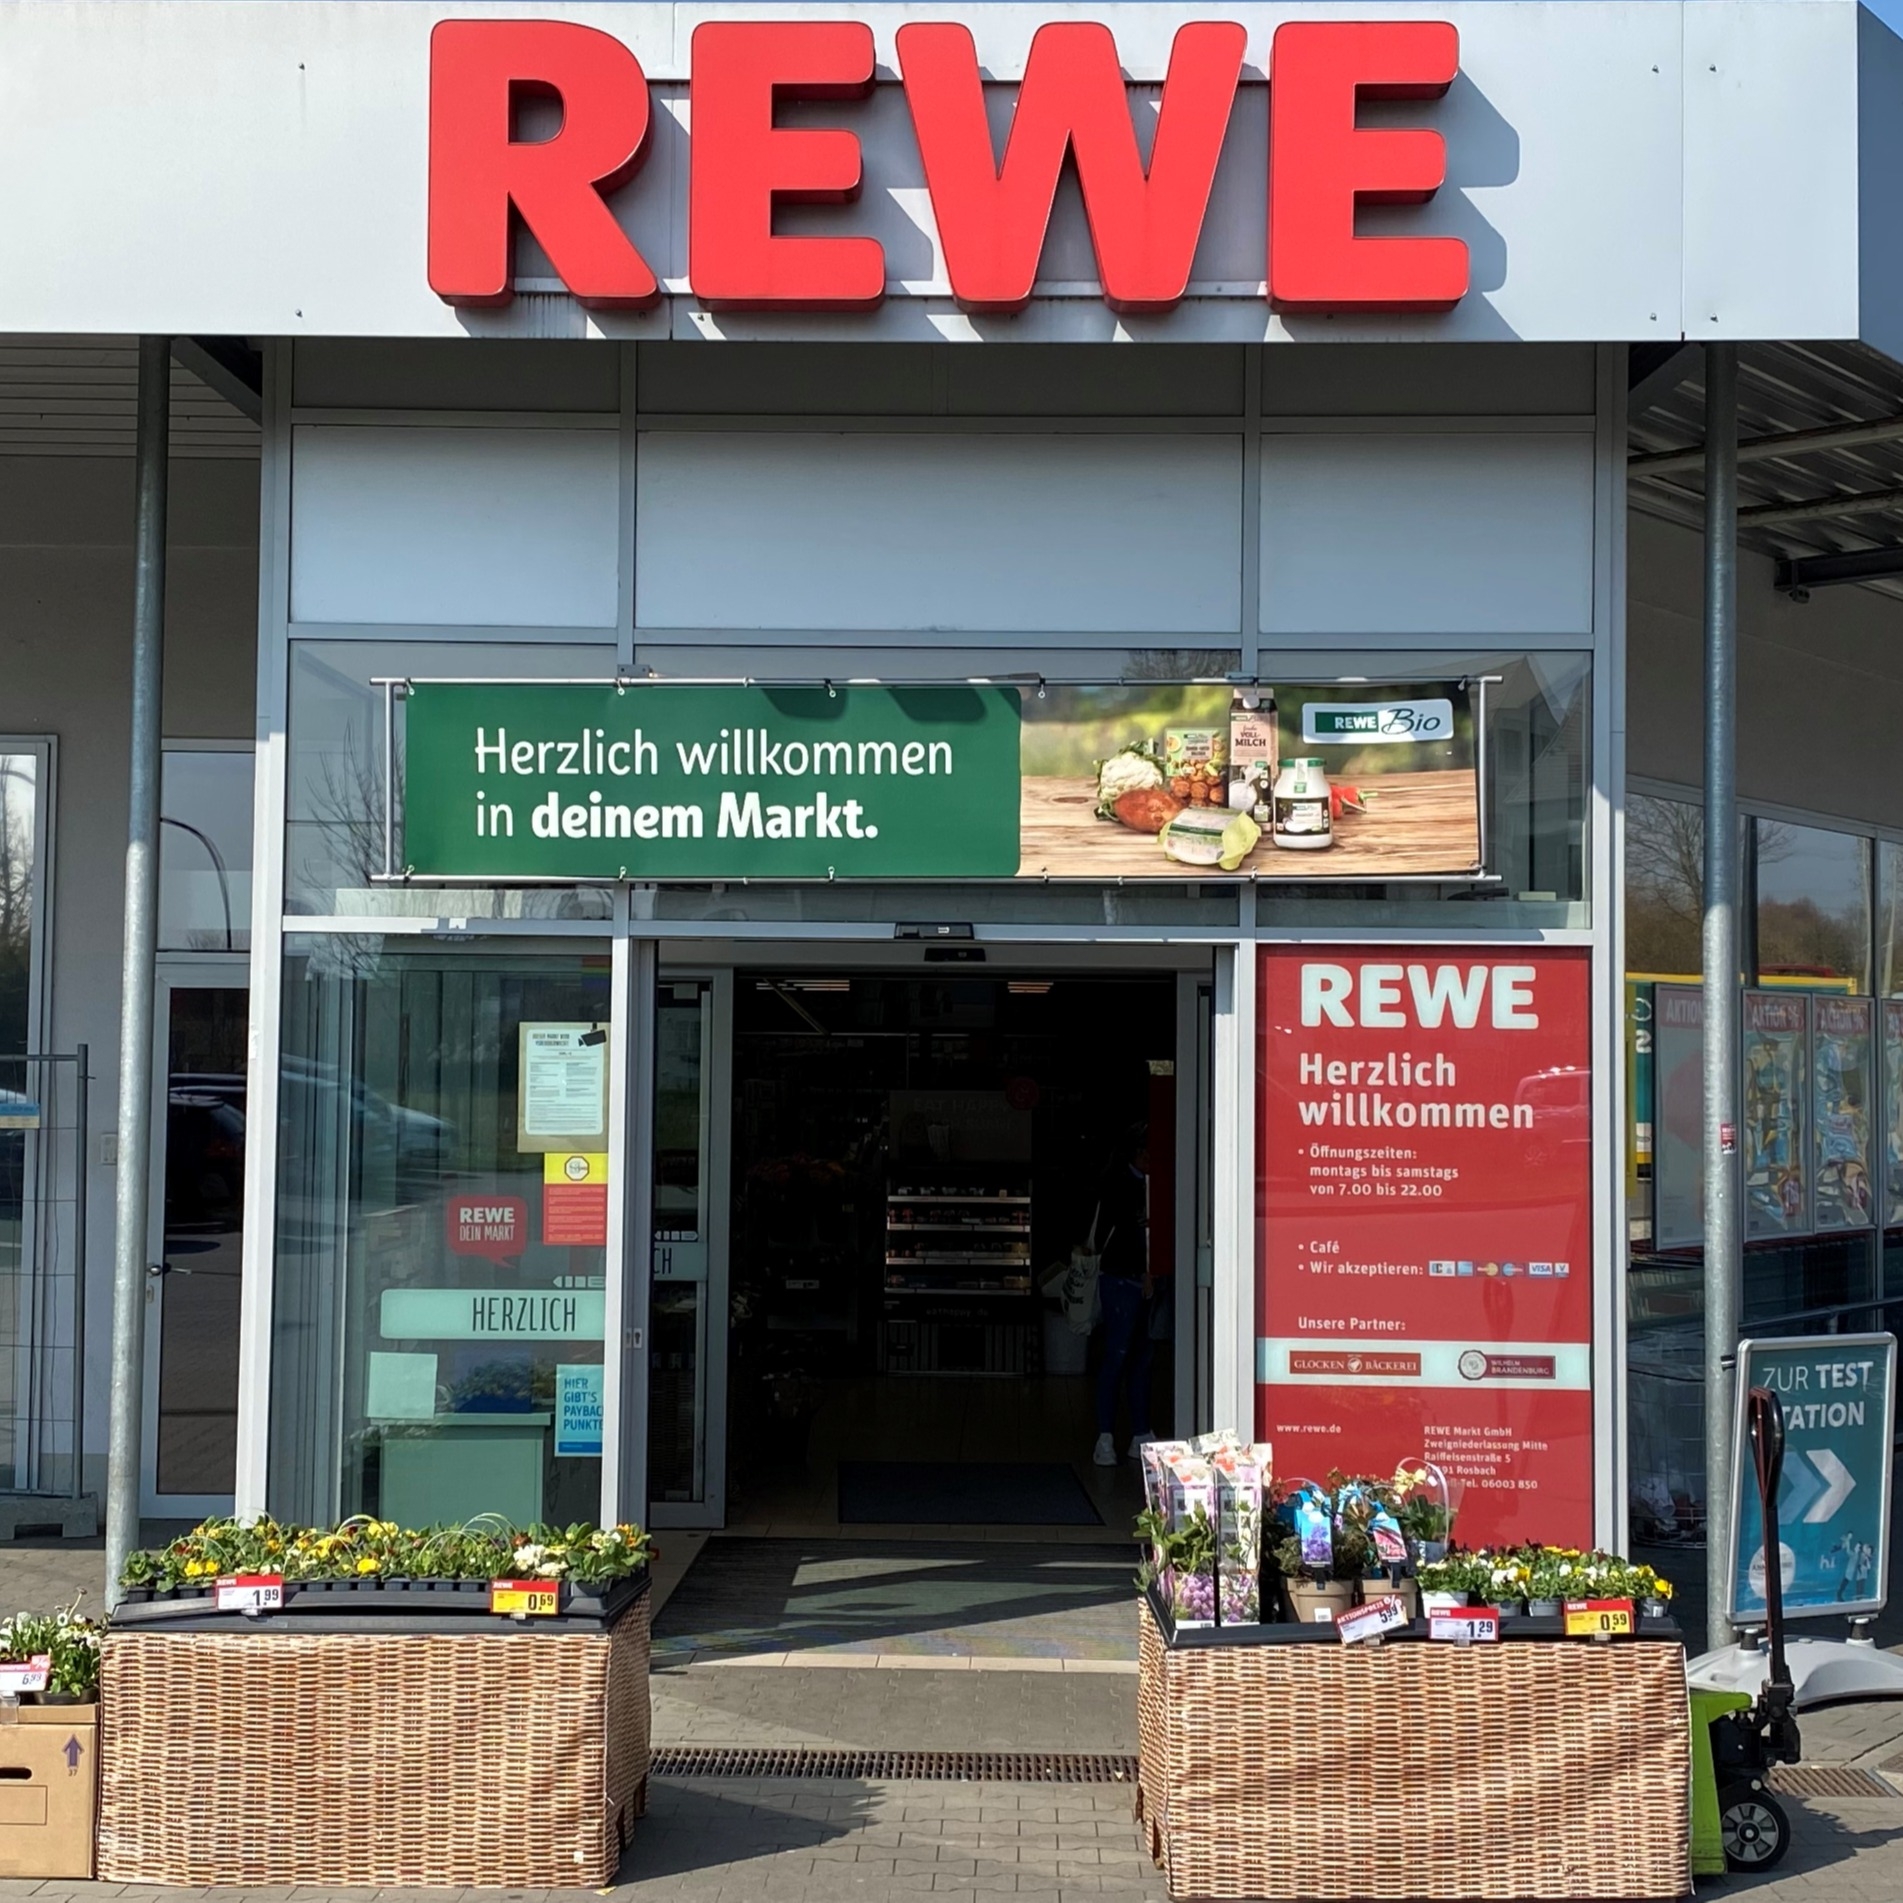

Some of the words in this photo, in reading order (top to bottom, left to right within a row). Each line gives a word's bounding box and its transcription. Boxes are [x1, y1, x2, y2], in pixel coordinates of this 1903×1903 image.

[428, 19, 1470, 311] REWE
[1333, 716, 1378, 730] REWE
[1381, 708, 1441, 734] Bio
[1235, 738, 1266, 747] MILCH
[475, 727, 658, 775] Herzlich
[676, 728, 953, 776] willkommen
[476, 790, 514, 837] in
[531, 791, 698, 838] deinem
[716, 791, 879, 839] Markt.
[1300, 963, 1540, 1030] REWE
[1300, 1052, 1456, 1087] Herzlich
[1299, 1092, 1534, 1129] willkommen
[1309, 1143, 1417, 1161] Öffnungszeiten:
[1309, 1164, 1367, 1180] montags
[1371, 1164, 1392, 1177] bis
[1396, 1165, 1459, 1181] samstags
[1309, 1184, 1334, 1195] von
[1339, 1183, 1372, 1196] 7.00
[1376, 1182, 1396, 1196] bis
[1400, 1184, 1443, 1197] 22.00
[459, 1207, 515, 1223] REWE
[459, 1225, 482, 1241] DEIN
[484, 1224, 515, 1241] MARKT
[1309, 1240, 1340, 1254] Café
[1309, 1261, 1334, 1274] Wir
[1338, 1261, 1424, 1277] akzeptieren:
[1531, 1264, 1551, 1273] VISA
[472, 1296, 577, 1332] HERZLICH
[1298, 1316, 1345, 1330] Unsere
[1350, 1317, 1406, 1331] Partner:
[1294, 1359, 1345, 1369] GLOCKEN
[1365, 1359, 1417, 1371] BÄCKEREI
[1491, 1366, 1550, 1375] BRANDENBURG
[564, 1378, 588, 1389] HIER
[1762, 1365, 1809, 1392] ZUR
[1815, 1361, 1874, 1391] TEST
[564, 1391, 598, 1403] GIBT'S
[564, 1405, 604, 1417] PAYBAC
[1781, 1401, 1864, 1430] TATION
[1276, 1424, 1342, 1435] www.rewe.de
[1424, 1426, 1450, 1435] REWE
[1453, 1426, 1481, 1436] Markt
[1484, 1427, 1512, 1437] GmbH
[1424, 1439, 1520, 1451] Zweigniederlassung
[1522, 1441, 1548, 1451] Mitte
[1424, 1452, 1502, 1462] Raiffeisenstraße
[1505, 1454, 1511, 1463] 5
[1456, 1465, 1496, 1475] Rosbach
[1481, 1480, 1515, 1489] 06003
[1518, 1480, 1538, 1489] 850
[1820, 1554, 1835, 1569] hi
[253, 1588, 279, 1606] 1.99
[528, 1593, 554, 1611] 0.69
[1336, 1600, 1384, 1624] AKTIONSPREIS
[1379, 1606, 1398, 1624] 5.99
[1466, 1620, 1493, 1637] 1.29
[1600, 1613, 1627, 1631] 0.59
